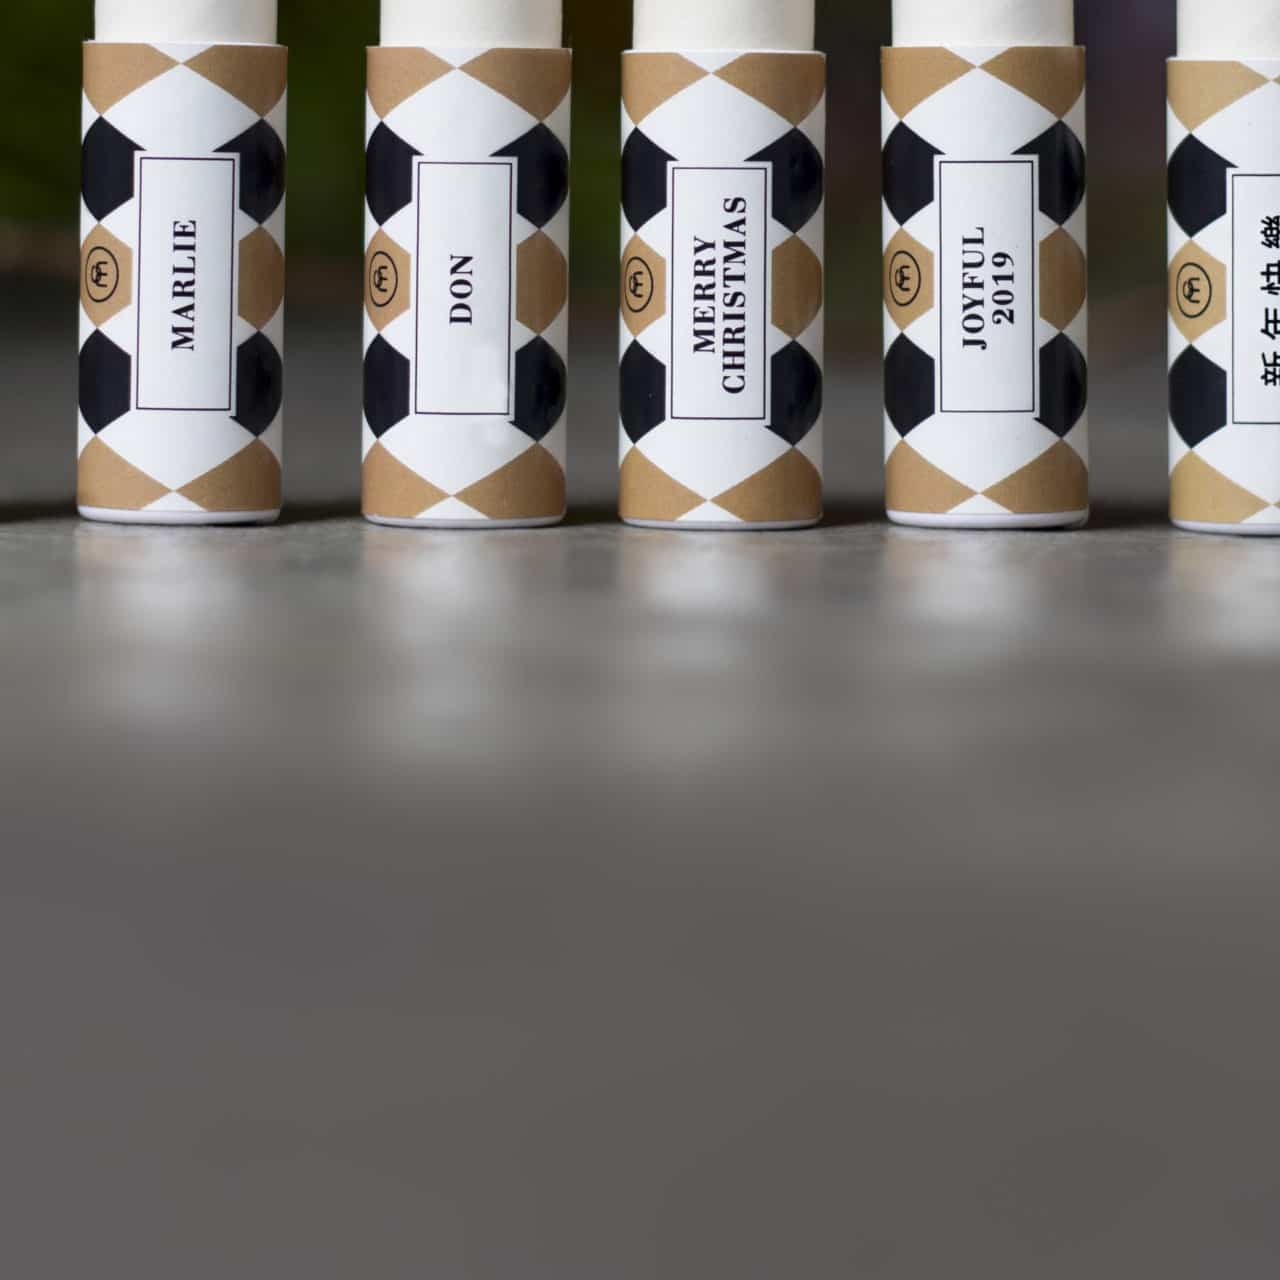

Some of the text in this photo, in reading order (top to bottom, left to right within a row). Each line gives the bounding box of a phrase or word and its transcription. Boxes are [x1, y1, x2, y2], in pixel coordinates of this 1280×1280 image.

[171, 218, 197, 351] MARLIE
[448, 254, 473, 324] DON
[692, 235, 716, 353] MERRY
[721, 195, 746, 394] CHRISTMAS
[961, 225, 987, 351] JOYFUL
[990, 250, 1015, 325] 2019
